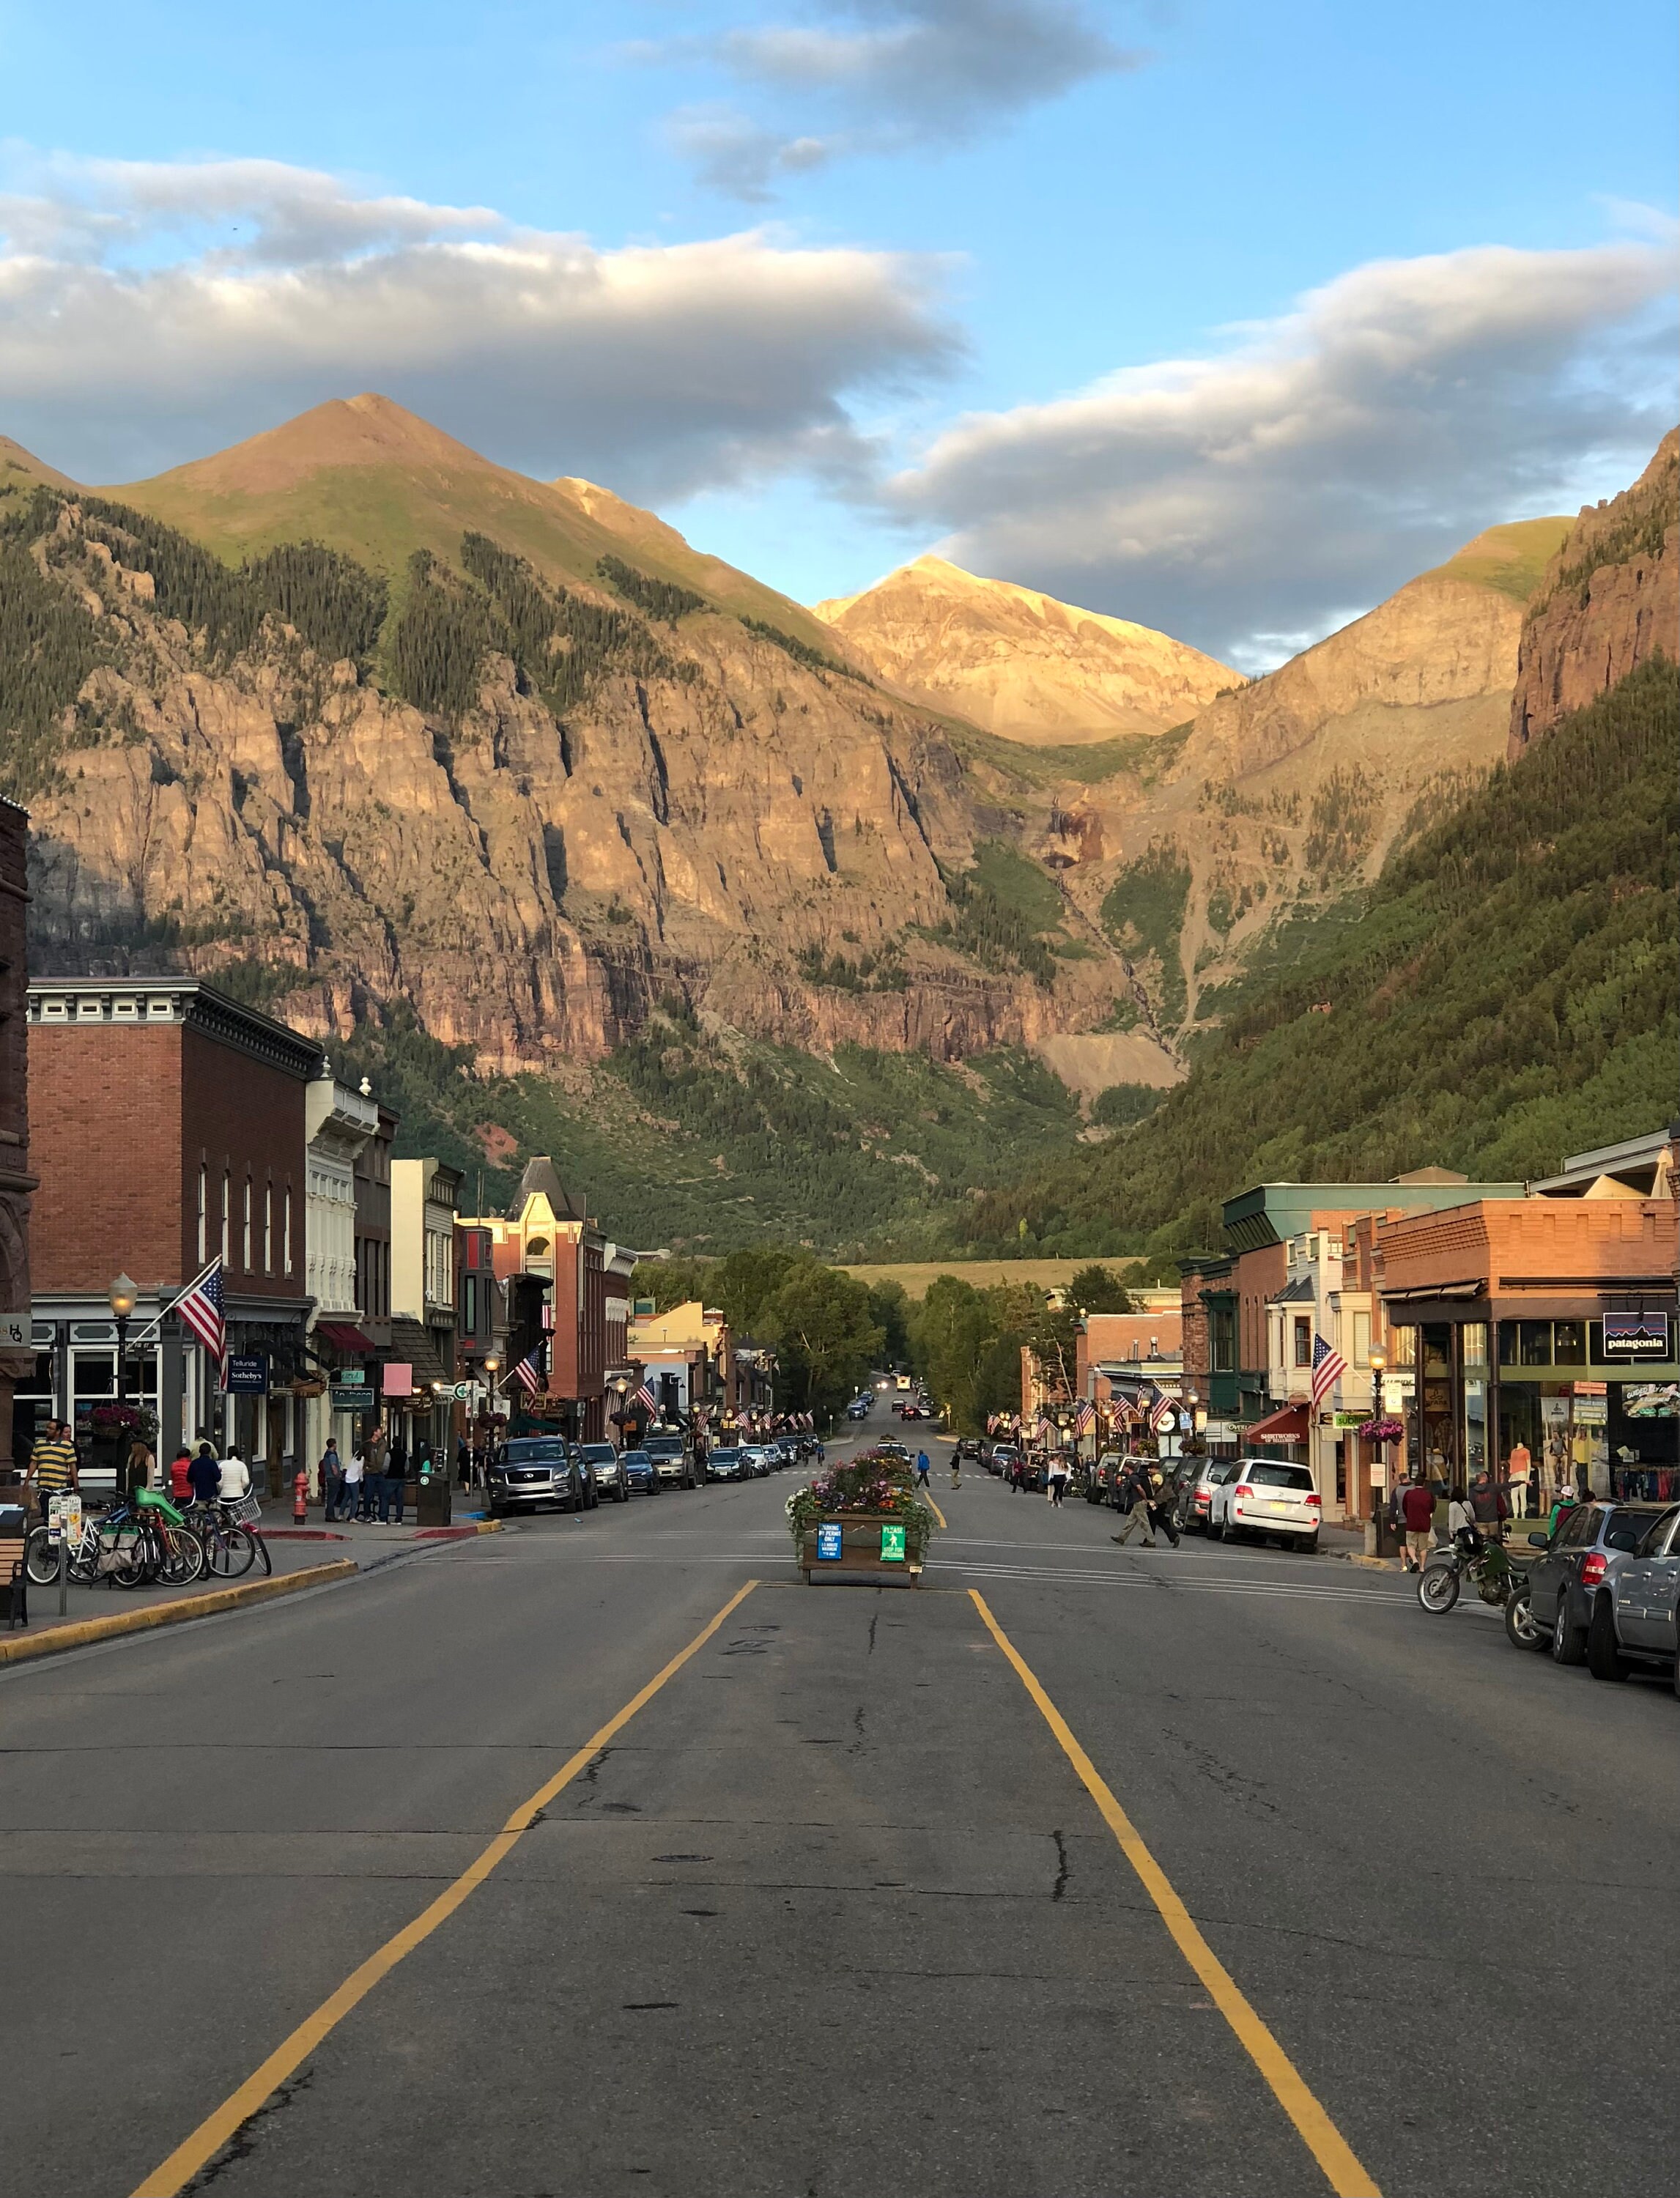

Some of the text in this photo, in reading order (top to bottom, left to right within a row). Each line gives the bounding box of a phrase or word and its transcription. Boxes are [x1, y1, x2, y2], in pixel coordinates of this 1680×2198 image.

[1607, 1338, 1664, 1350] patagonia
[232, 1359, 258, 1367] Telluride
[231, 1371, 263, 1380] Sotheby's
[1627, 1387, 1648, 1399] GUIDED
